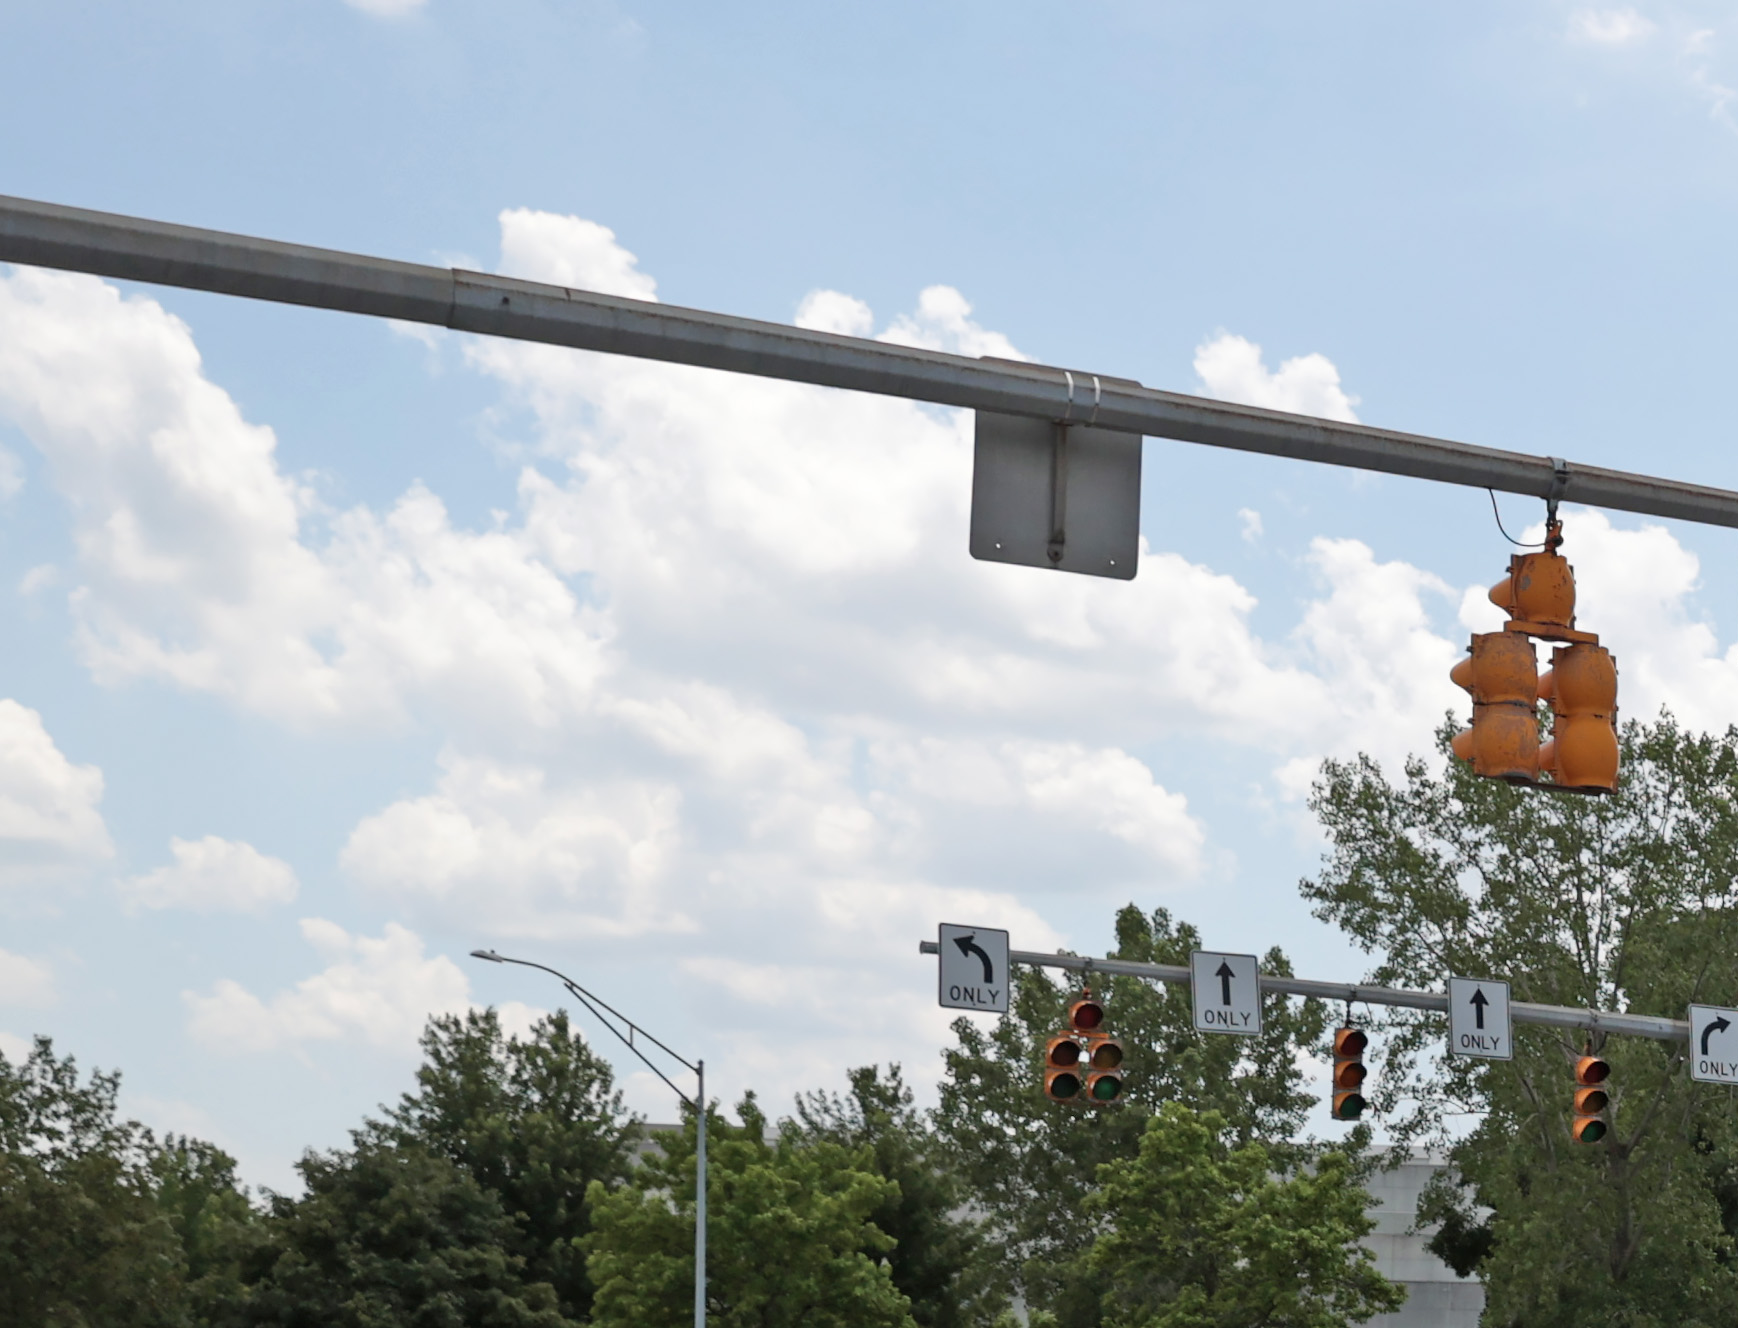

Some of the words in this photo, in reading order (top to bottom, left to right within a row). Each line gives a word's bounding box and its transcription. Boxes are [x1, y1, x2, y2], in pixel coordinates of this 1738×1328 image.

[949, 984, 1000, 1005] ONLY
[1204, 1009, 1251, 1026] ONLY
[1460, 1033, 1500, 1050] ONLY
[1699, 1060, 1738, 1077] ONLY
